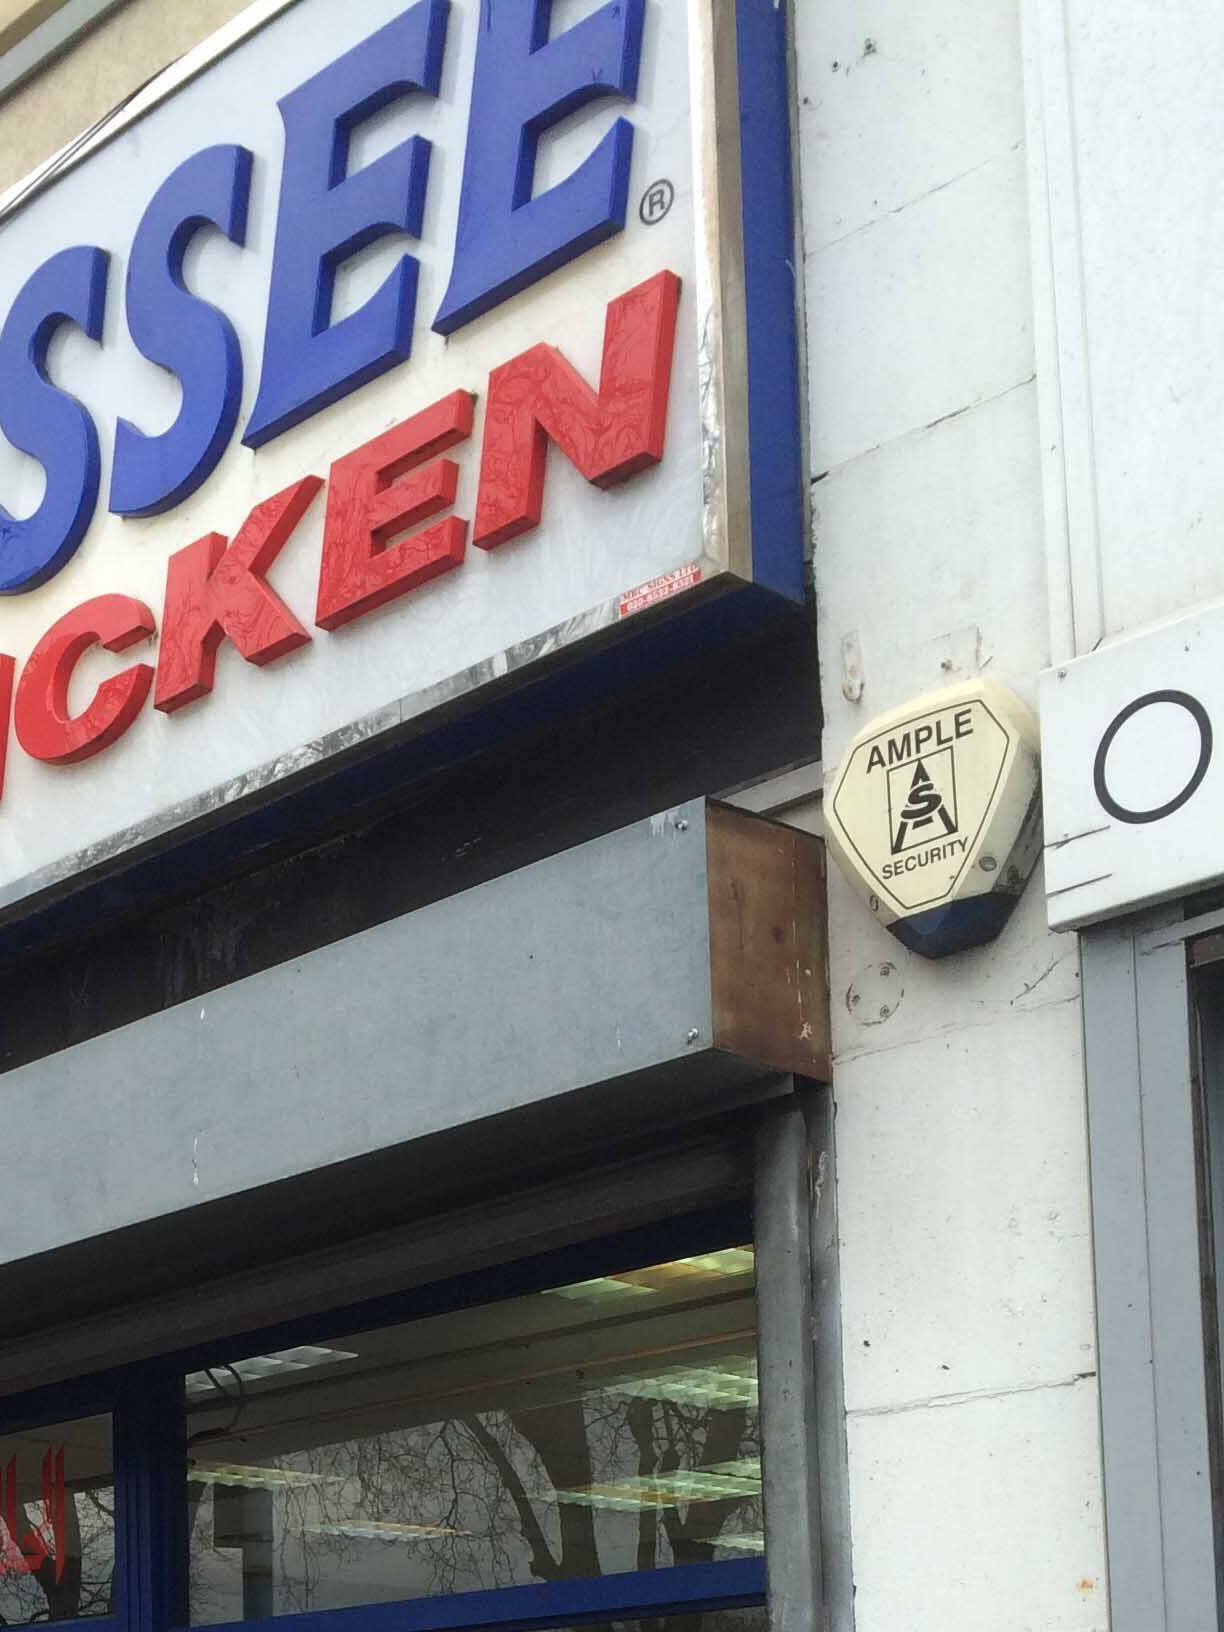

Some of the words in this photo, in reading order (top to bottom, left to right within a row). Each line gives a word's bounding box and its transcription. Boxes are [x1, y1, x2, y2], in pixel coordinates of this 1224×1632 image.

[866, 708, 974, 774] AMPLE
[1094, 689, 1213, 824] O
[882, 836, 969, 880] SECURITY
